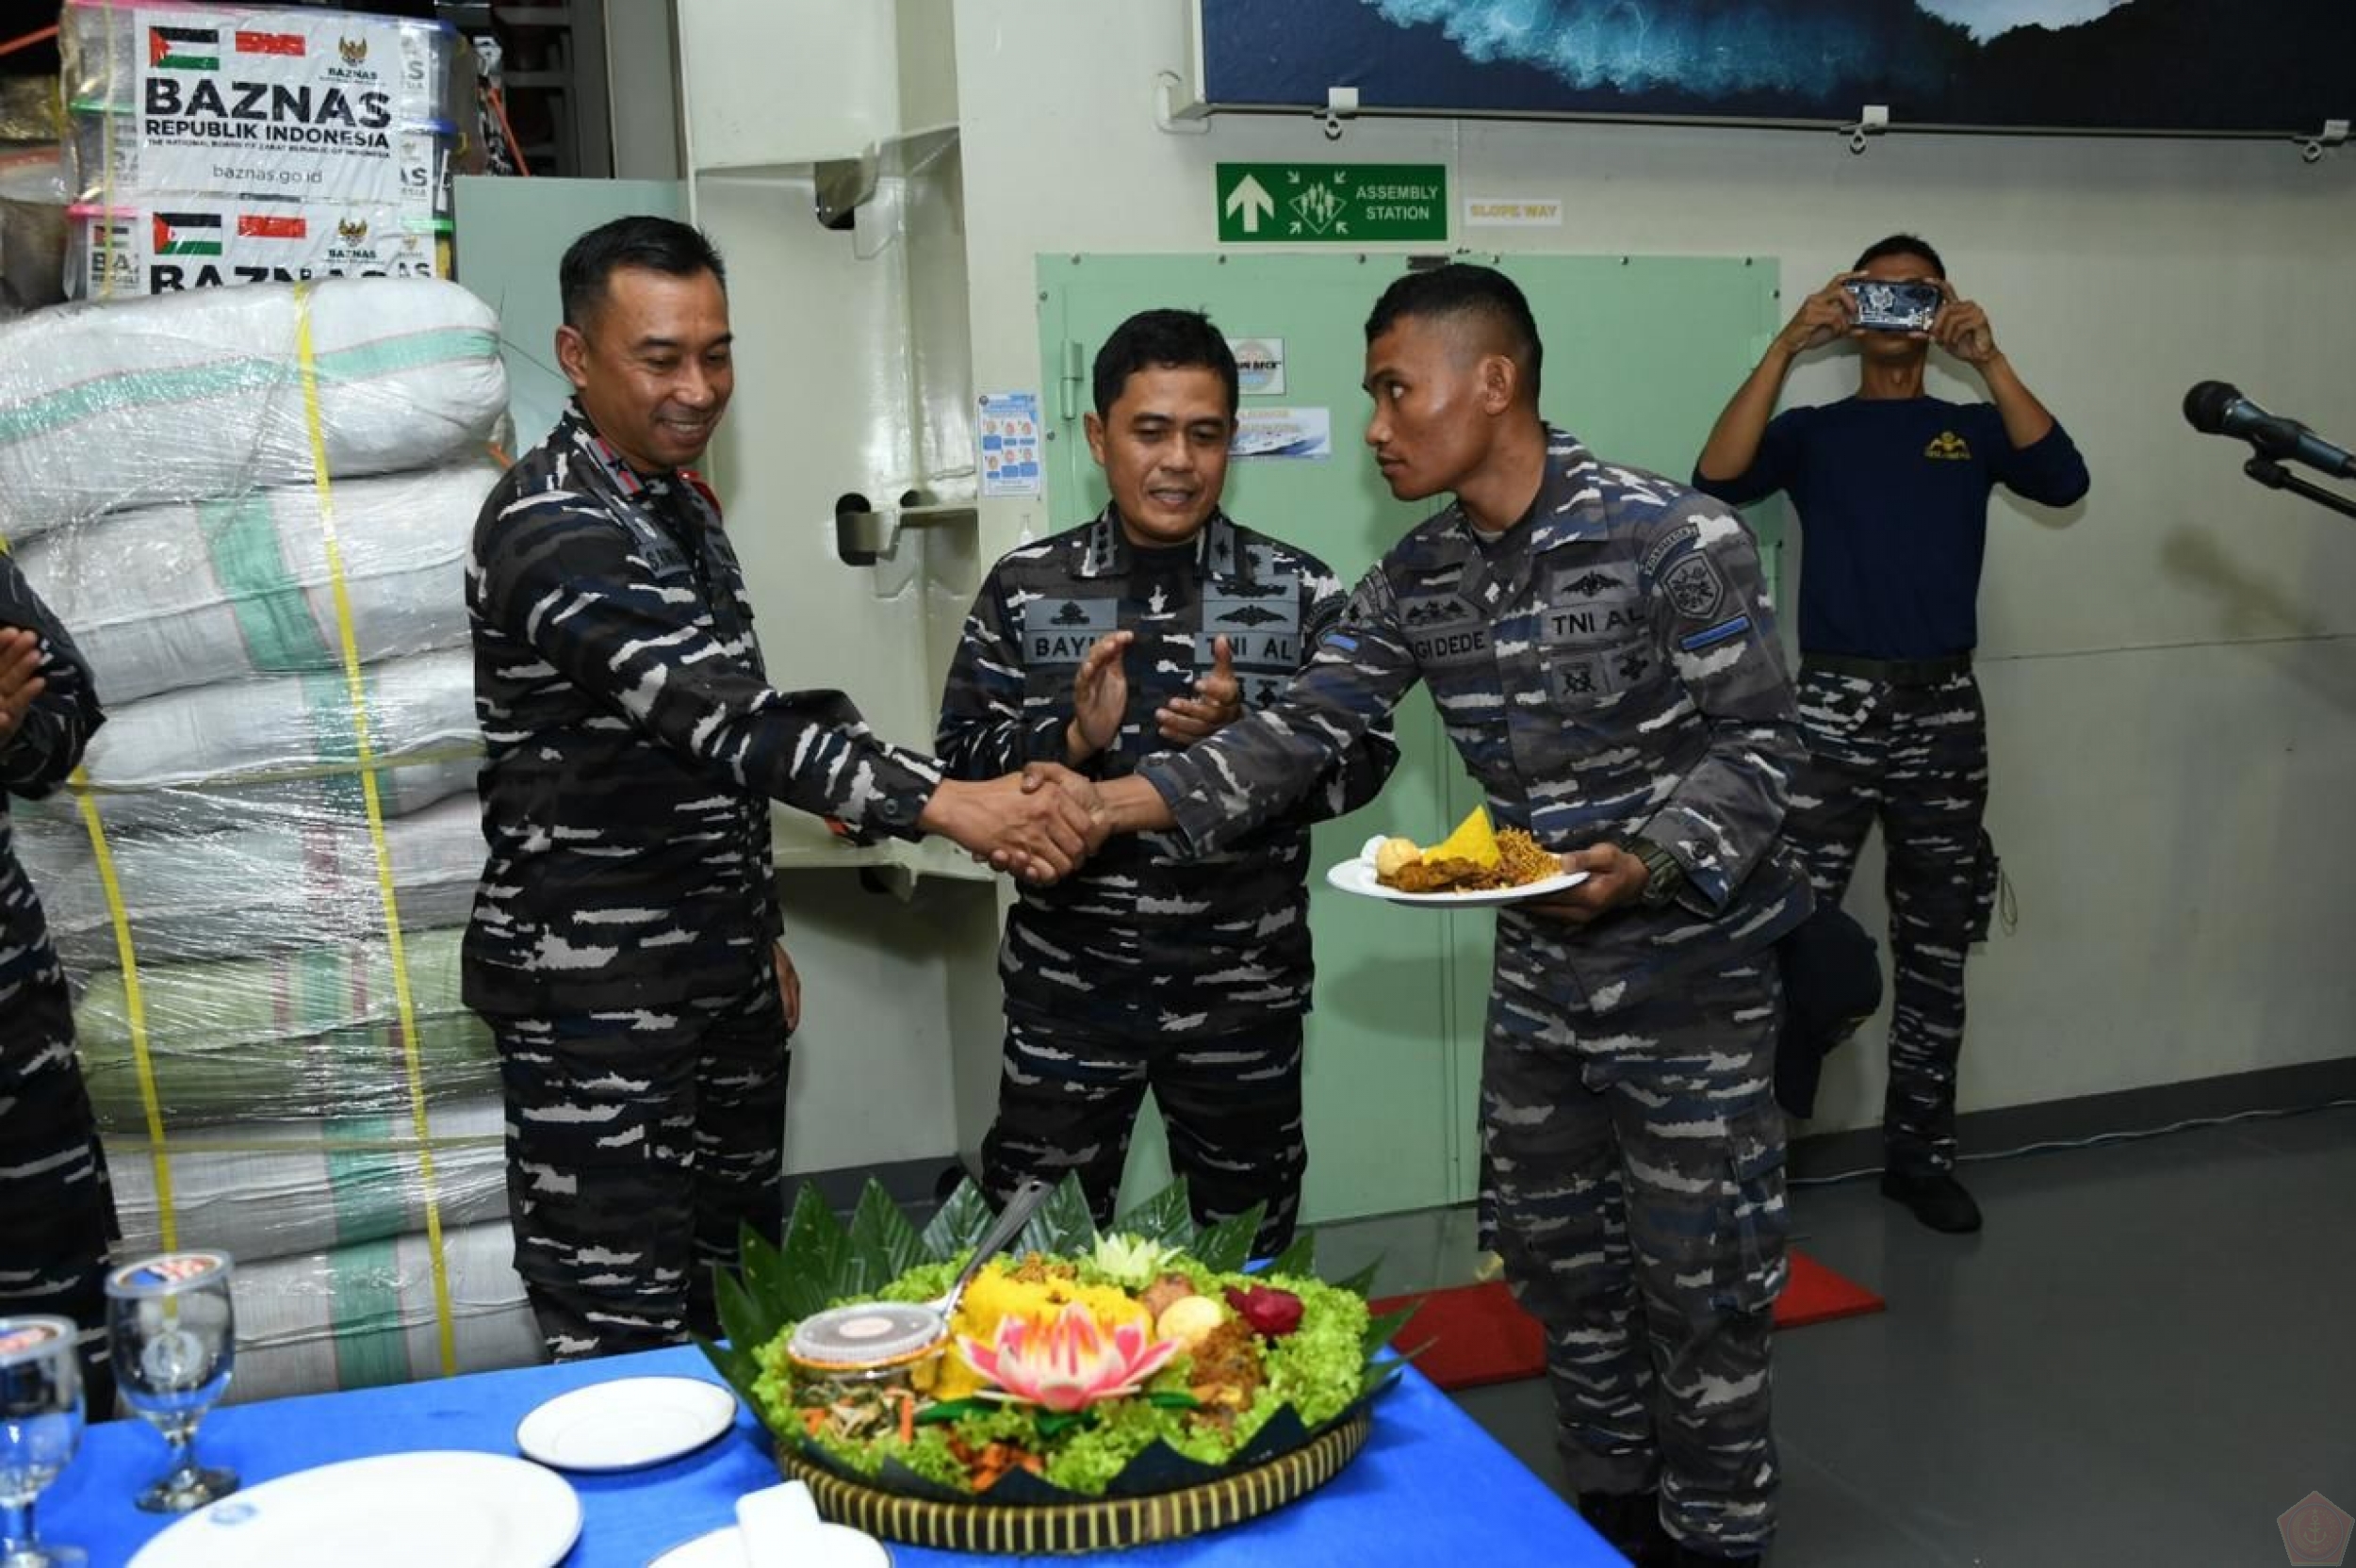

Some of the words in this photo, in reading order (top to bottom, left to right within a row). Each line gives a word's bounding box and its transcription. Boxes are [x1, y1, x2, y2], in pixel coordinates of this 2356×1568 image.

[145, 77, 391, 128] BAZNAS
[146, 120, 257, 139] REPUBLIK
[266, 122, 390, 150] INDONESIA
[213, 165, 323, 184] baznas.go.id
[1355, 186, 1438, 200] ASSEMBLY
[1366, 205, 1430, 220] STATION
[1470, 204, 1518, 218] SLOPE
[1525, 204, 1558, 218] WAY
[1551, 612, 1595, 636] TNI
[1605, 608, 1645, 630] AL
[1264, 637, 1292, 660] AL
